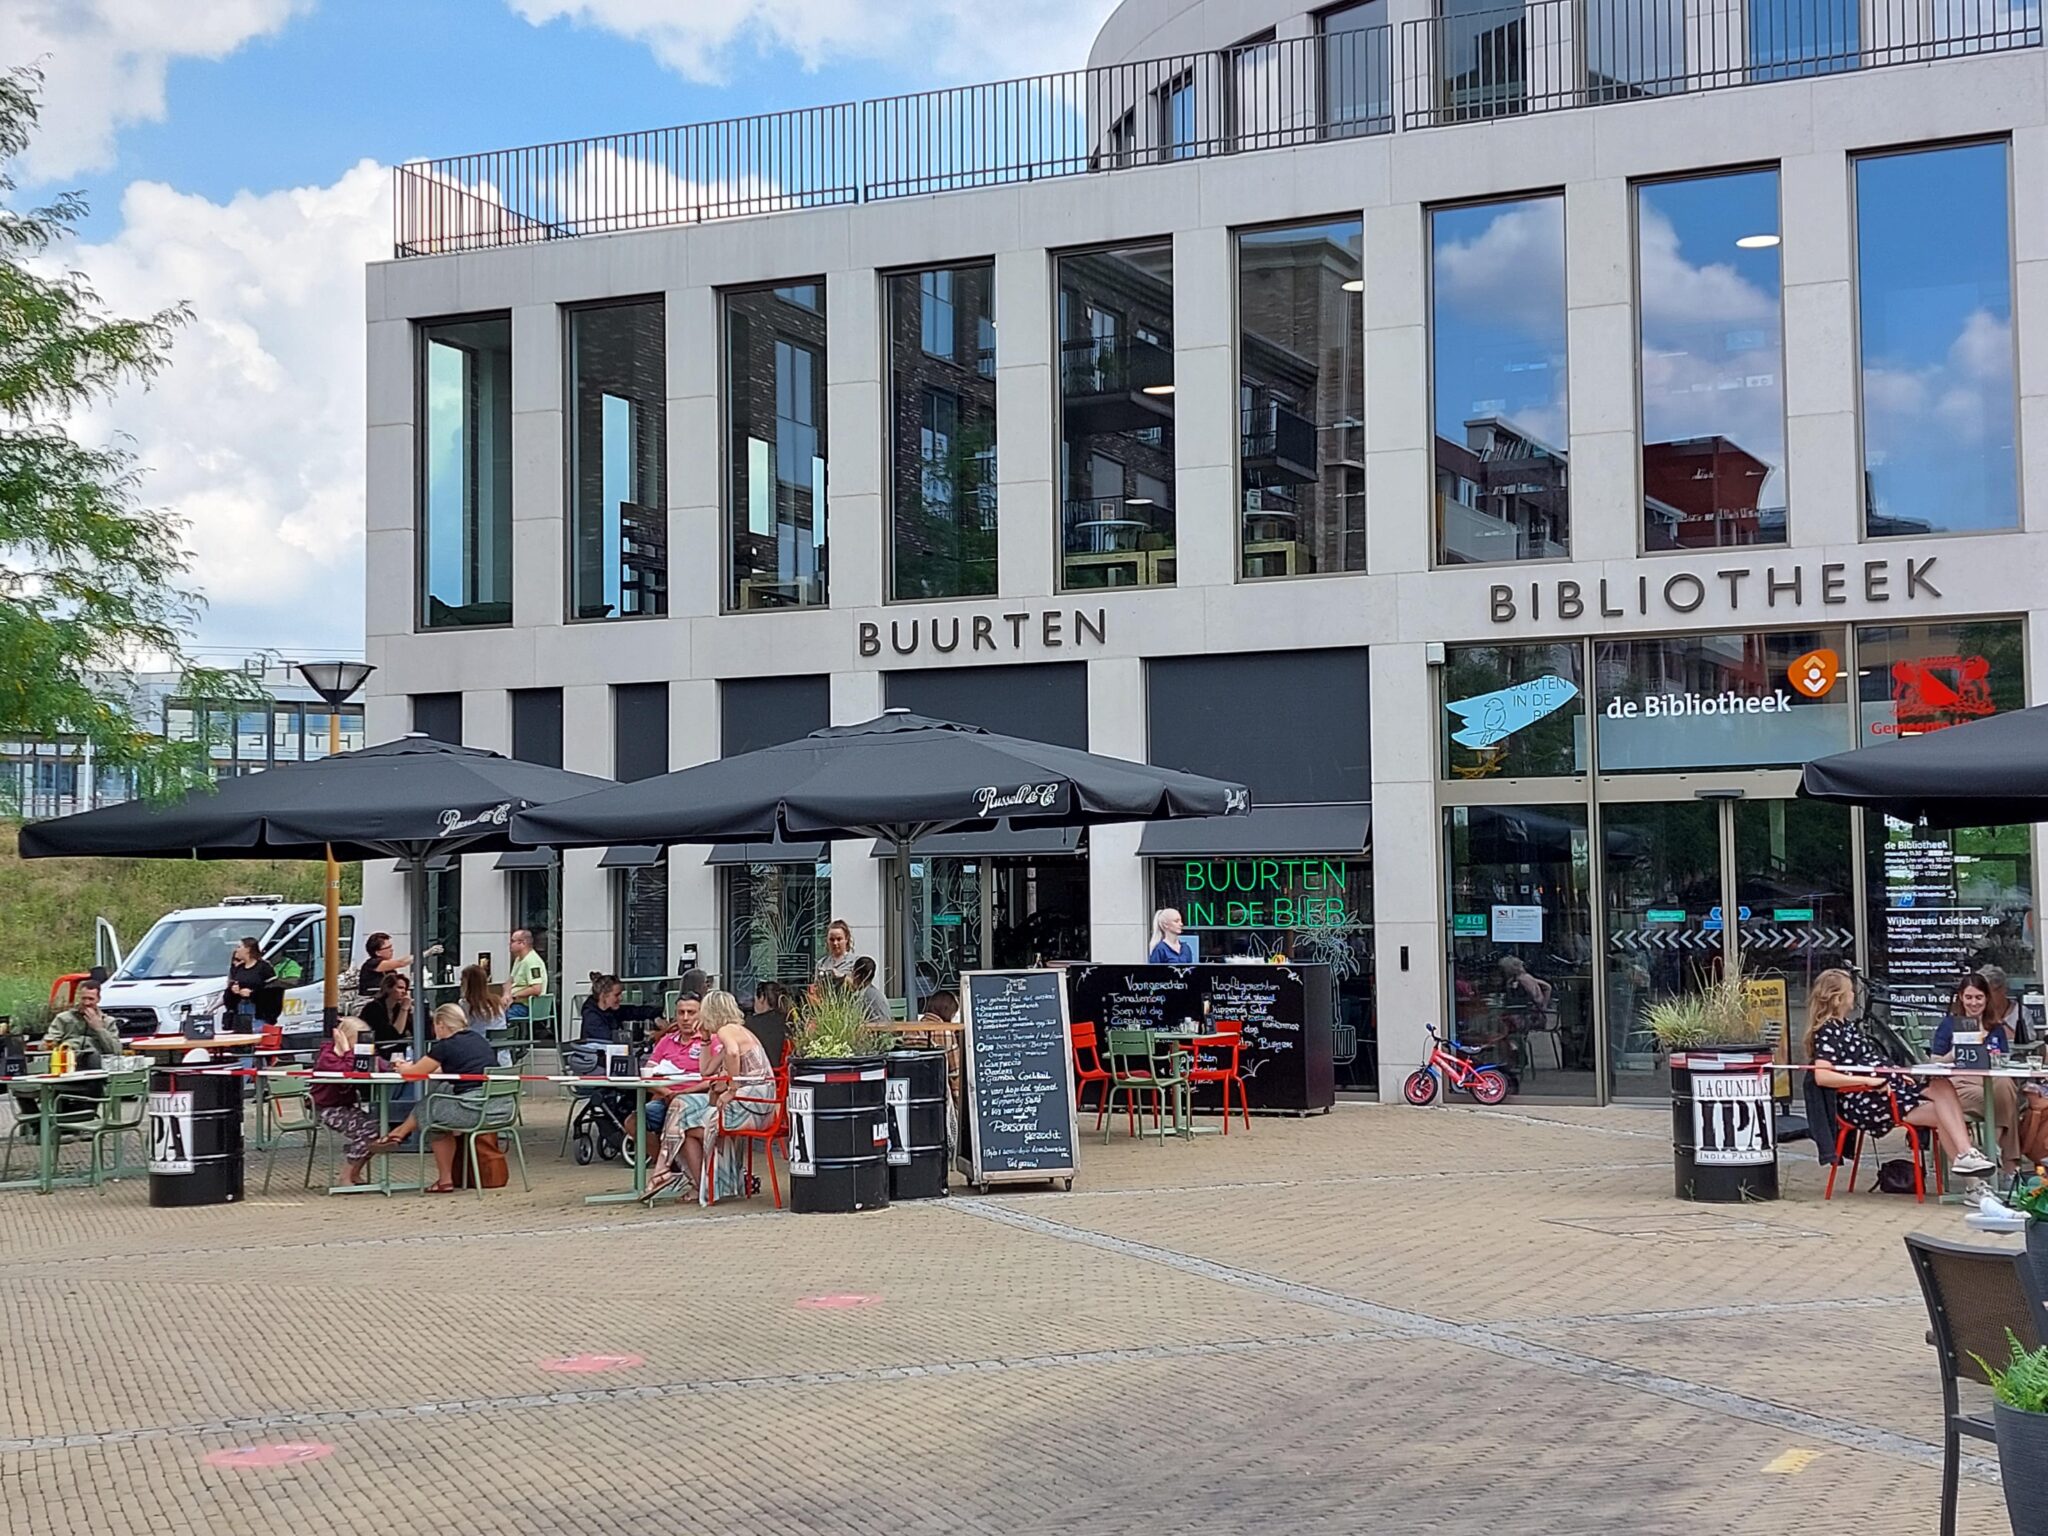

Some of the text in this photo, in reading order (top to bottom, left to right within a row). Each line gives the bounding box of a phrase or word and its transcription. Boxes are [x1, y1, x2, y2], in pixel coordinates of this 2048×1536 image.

[1490, 557, 1942, 623] BIBLIOTHEEK
[859, 608, 1106, 657] BUURTEN
[1509, 677, 1566, 691] URTEN
[1513, 693, 1552, 707] IN DE
[1606, 689, 1792, 719] de Bibliotheek
[1185, 860, 1346, 892] BUURTEN
[1187, 898, 1346, 928] IN DE BIEB
[1886, 915, 1999, 927] Wijkbureau Leidsche Rijn
[1957, 1049, 1978, 1061] 213
[1697, 1078, 1769, 1098] LAGUNITAS
[989, 1119, 1039, 1133] Personeel
[1697, 1099, 1772, 1152] IPA
[149, 1115, 187, 1162] PA
[1700, 1151, 1727, 1160] INDIA
[1732, 1151, 1755, 1161] PALE
